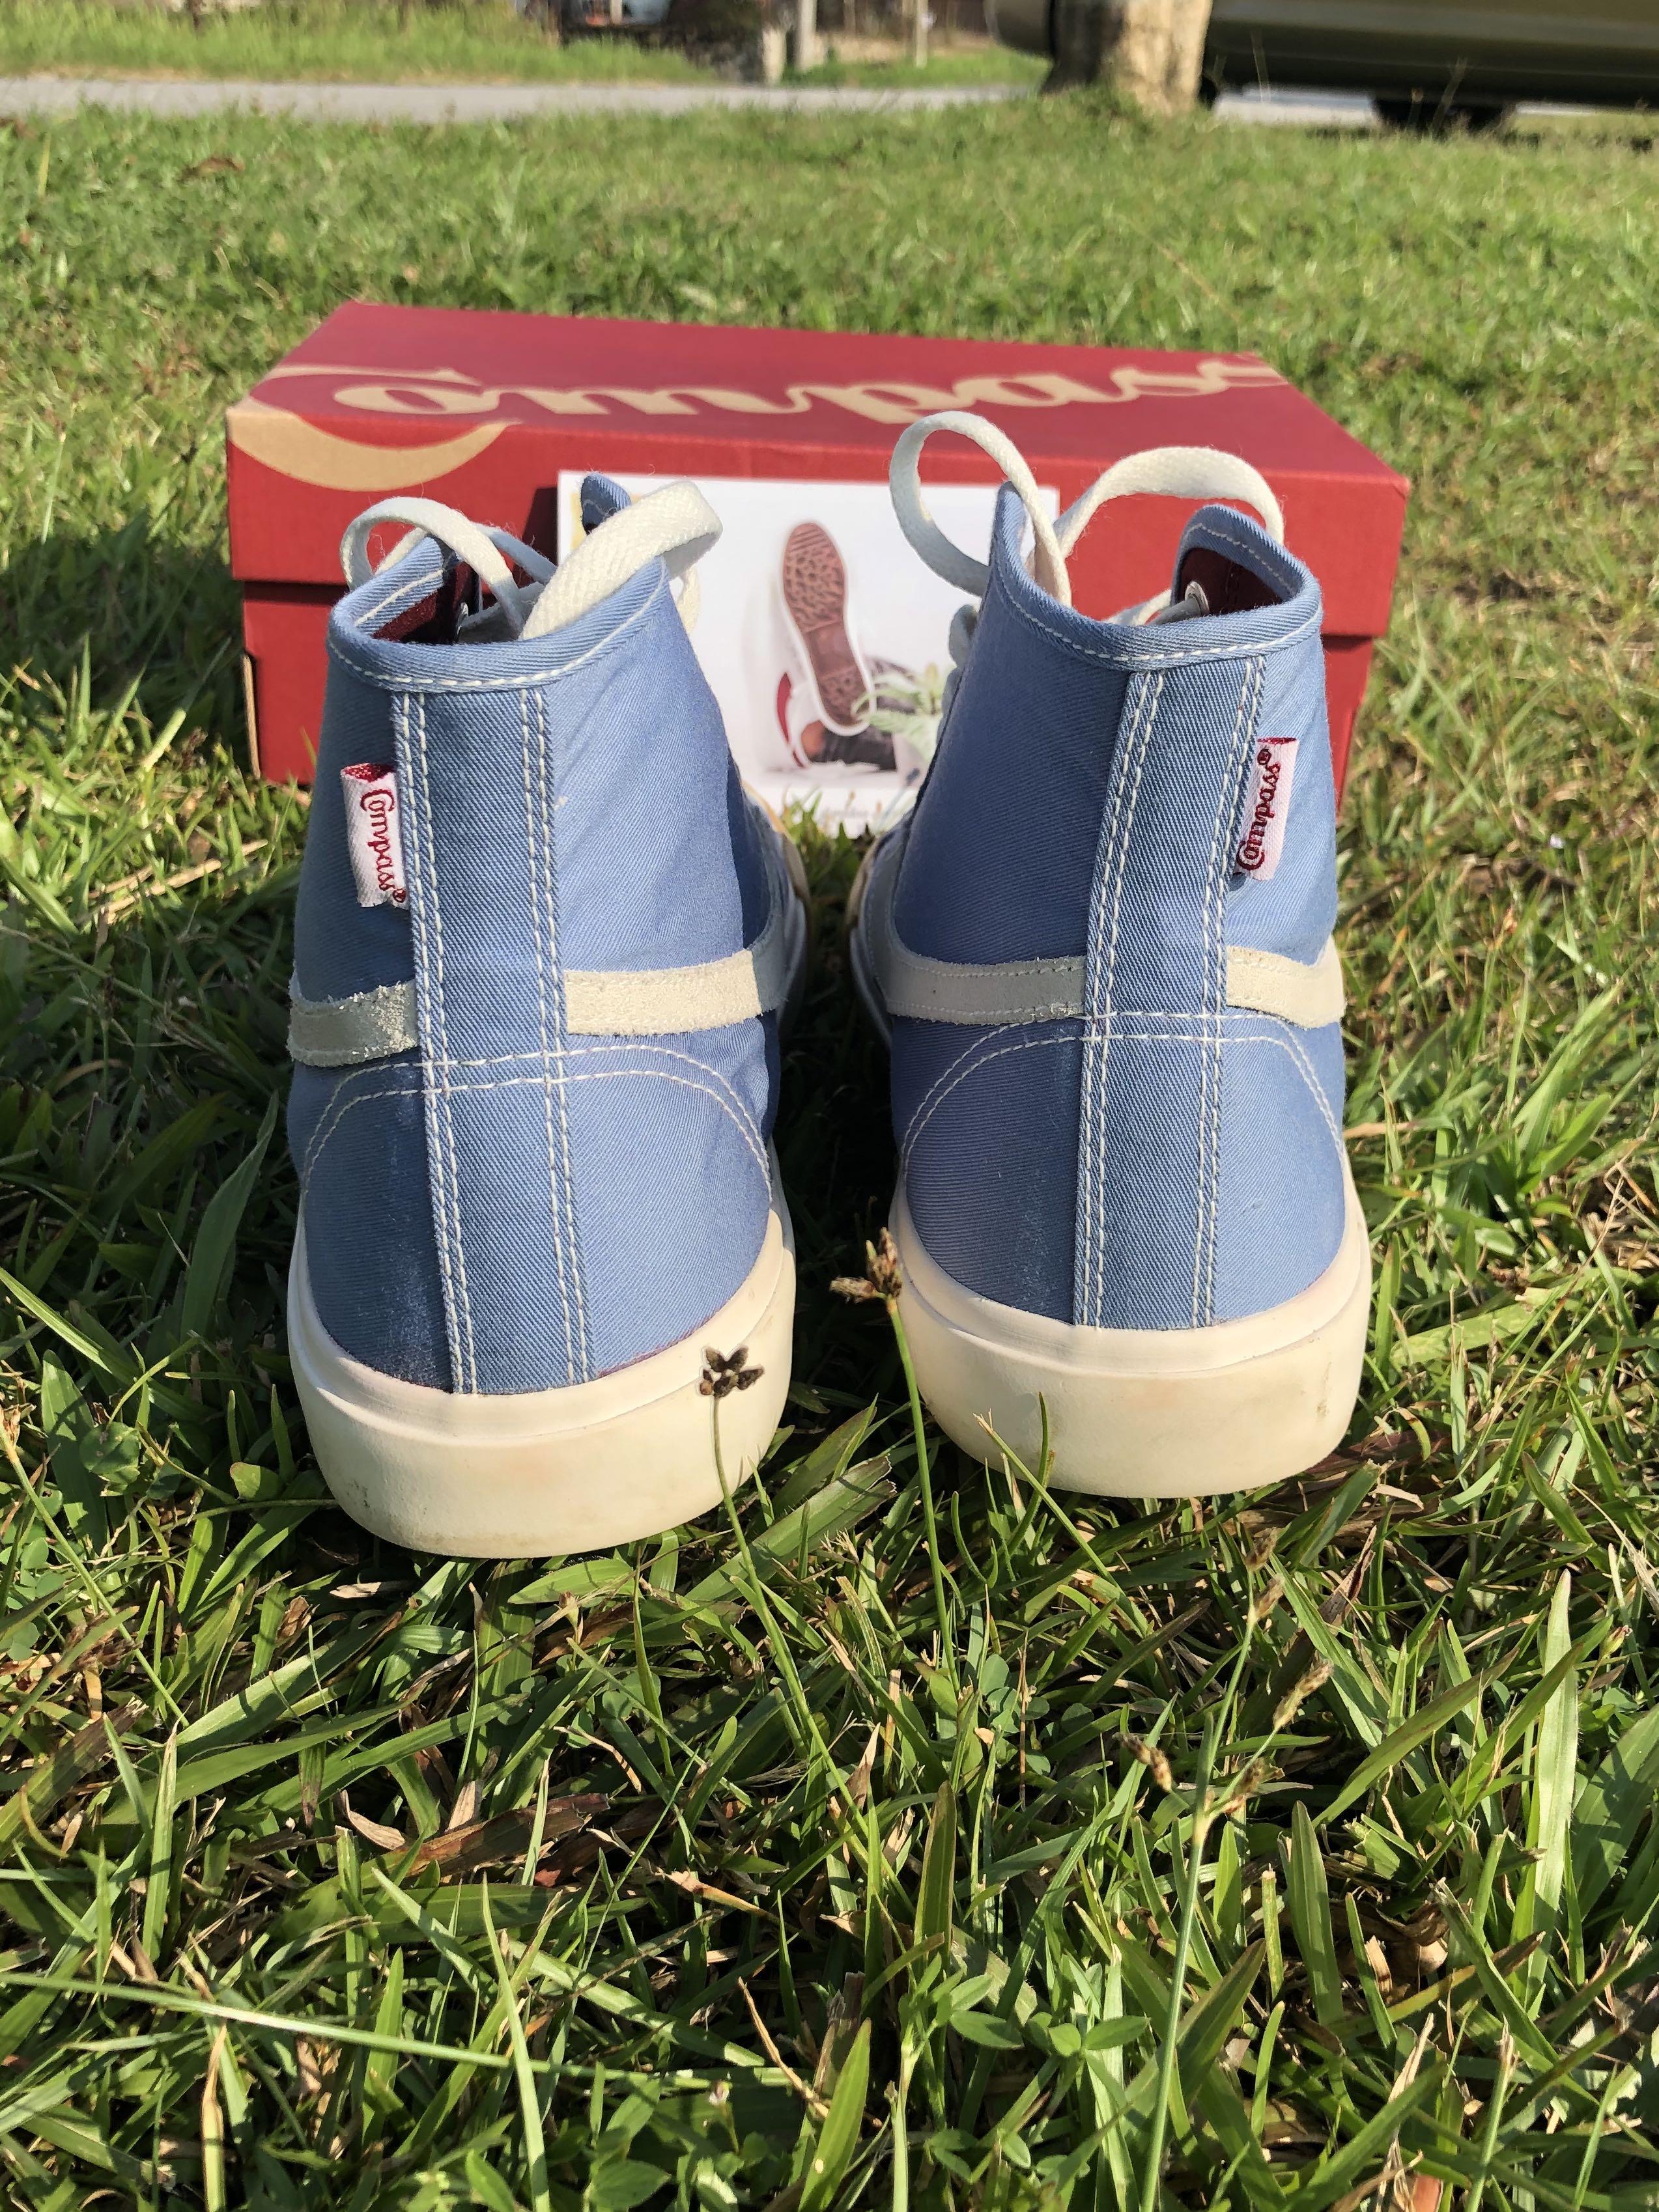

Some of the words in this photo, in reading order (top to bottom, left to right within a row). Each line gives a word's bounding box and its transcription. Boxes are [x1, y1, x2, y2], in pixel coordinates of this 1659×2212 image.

[226, 361, 1288, 492] Compass
[360, 789, 395, 891] Compass
[1236, 762, 1281, 871] Compass
